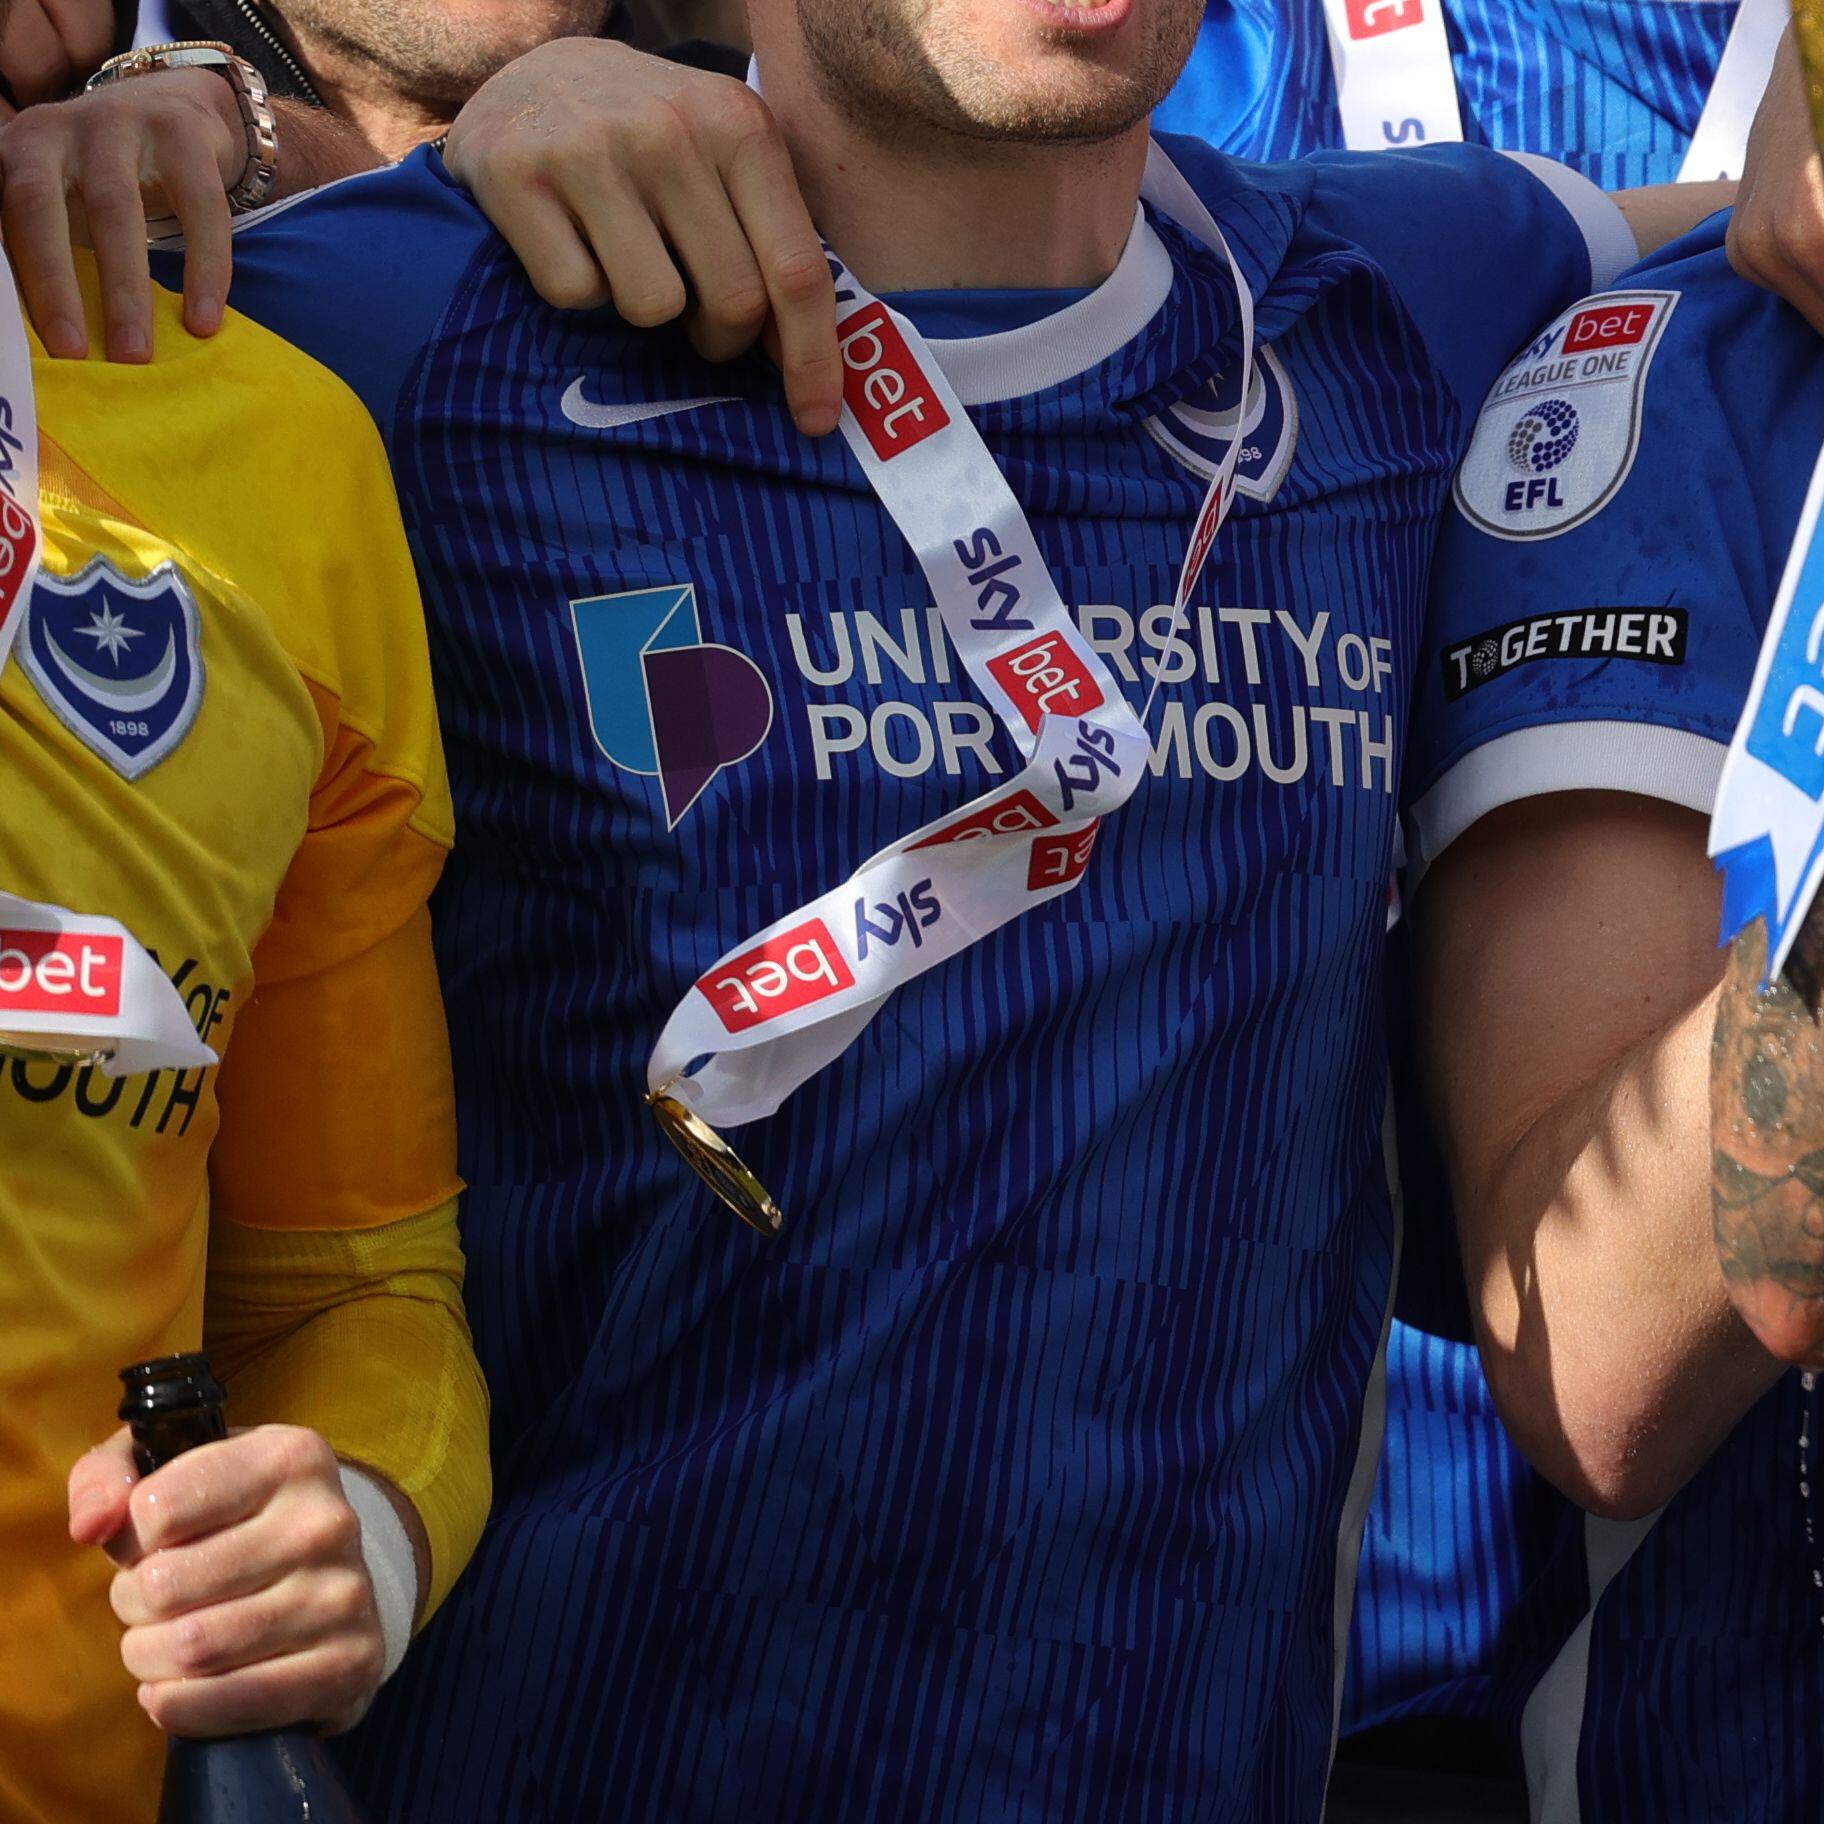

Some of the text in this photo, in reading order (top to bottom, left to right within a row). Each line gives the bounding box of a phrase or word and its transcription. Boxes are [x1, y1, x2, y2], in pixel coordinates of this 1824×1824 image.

[1573, 310, 1642, 343] bet
[839, 317, 925, 440] bet
[1495, 350, 1632, 396] LEAGUE ONE
[1504, 477, 1564, 512] EFL
[954, 526, 1081, 716] sky bet
[1336, 632, 1393, 694] OF
[109, 719, 150, 737] 1898
[1054, 719, 1122, 813] sky
[0, 933, 109, 999] bet
[714, 877, 942, 1014] sky bet
[185, 982, 231, 1044] OF
